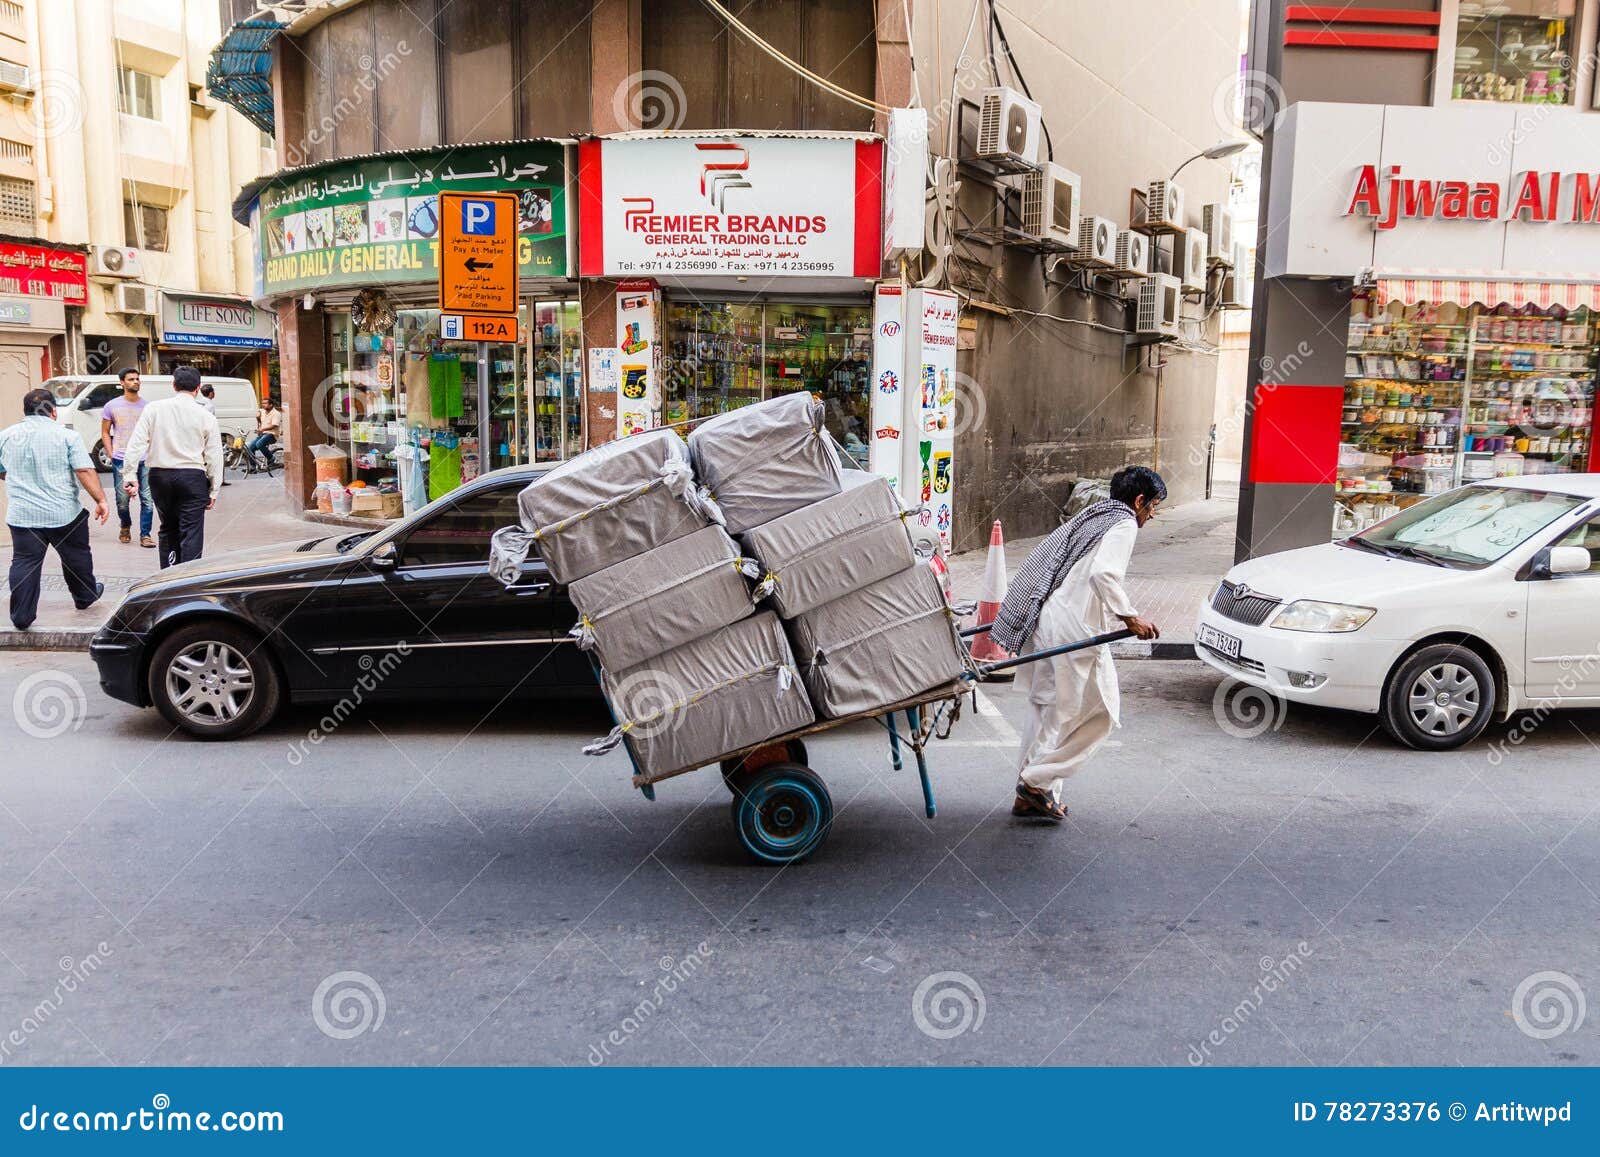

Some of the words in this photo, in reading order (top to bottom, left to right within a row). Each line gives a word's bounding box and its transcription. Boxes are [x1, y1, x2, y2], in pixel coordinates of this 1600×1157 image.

[1347, 164, 1501, 231] Ajwaa
[466, 202, 490, 233] P
[622, 197, 720, 233] PREMIER
[727, 215, 826, 234] BRANDS
[454, 246, 466, 254] Pay
[483, 247, 504, 255] Meter
[644, 234, 707, 246] GENERAL
[710, 234, 770, 246] TRADING
[774, 234, 807, 246] L.L.C
[266, 257, 298, 283] GRAND
[300, 250, 336, 279] DAILY
[340, 242, 423, 274] GENERAL
[618, 262, 636, 271] Tel:
[639, 262, 663, 271] +971
[666, 262, 673, 271] 4
[675, 262, 718, 271] 2356990
[727, 262, 750, 272] Fax:
[753, 262, 779, 272] +971
[781, 263, 788, 272] 4
[790, 262, 835, 272] 2356995
[182, 304, 212, 323] LIFE
[216, 307, 253, 326] SONG
[472, 322, 495, 335] 112
[497, 323, 508, 336] A
[1216, 633, 1238, 656] 75248
